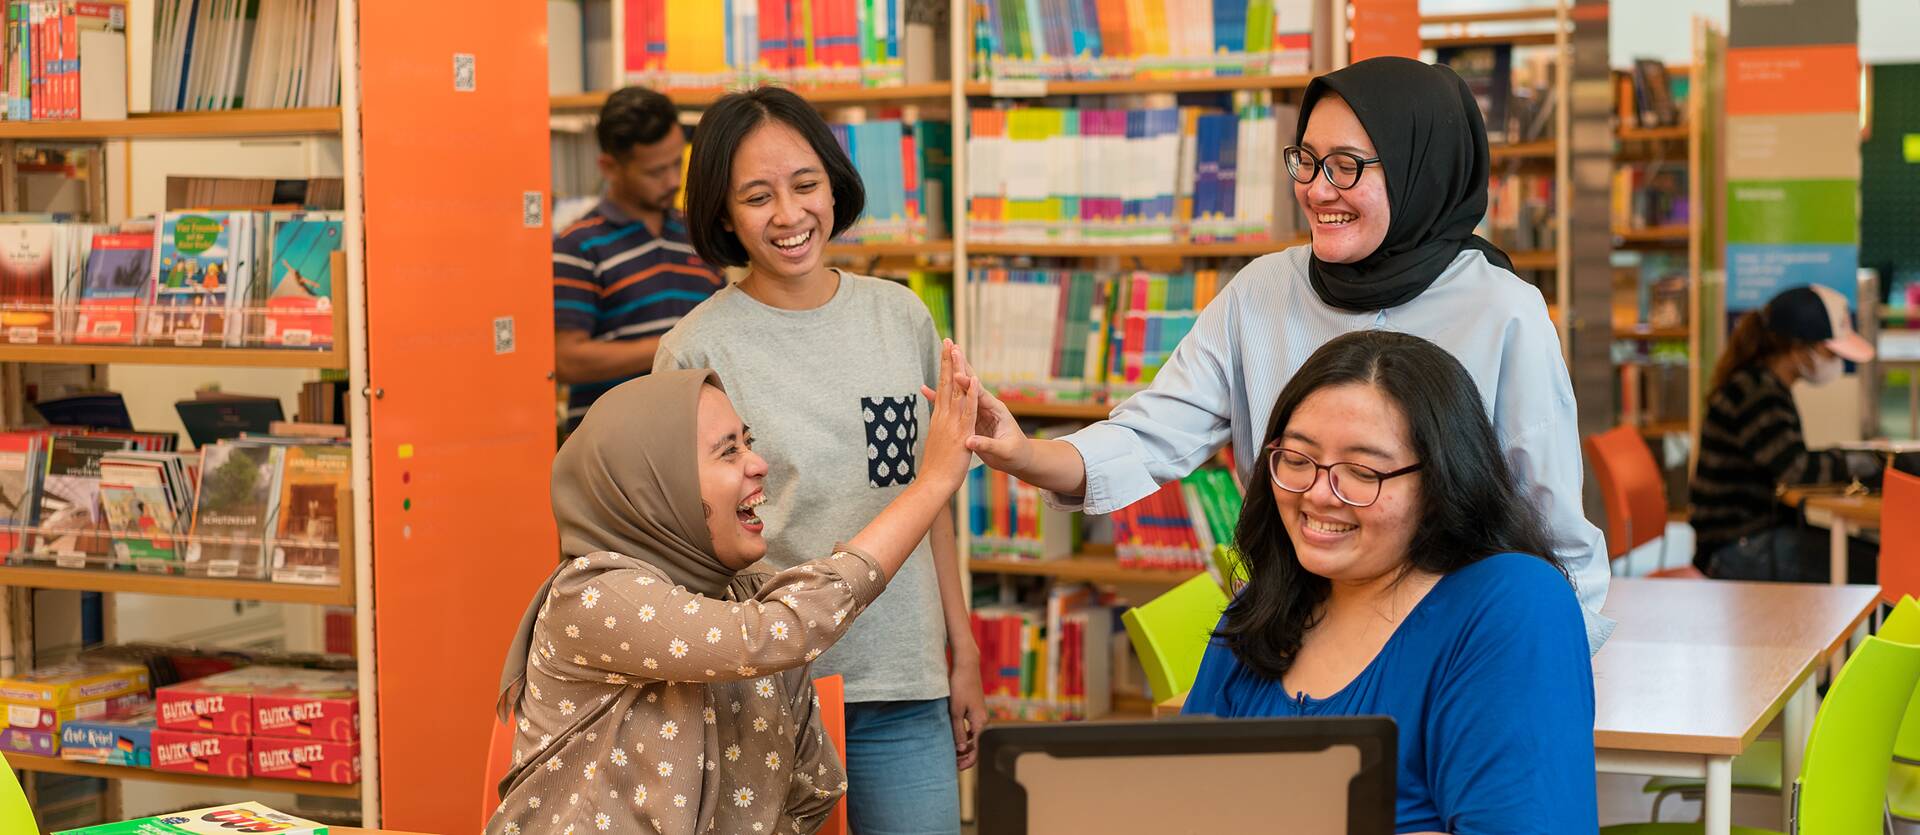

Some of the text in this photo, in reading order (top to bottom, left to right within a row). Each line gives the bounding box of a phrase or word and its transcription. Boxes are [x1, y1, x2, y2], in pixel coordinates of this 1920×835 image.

[162, 701, 192, 719] QUICK
[195, 696, 225, 715] BUZZ
[259, 702, 324, 725] QUICK BUZZ
[157, 744, 189, 763] QUICK
[190, 738, 221, 757] BUZZ
[259, 750, 291, 768] QUICK
[292, 745, 324, 763] BUZZ
